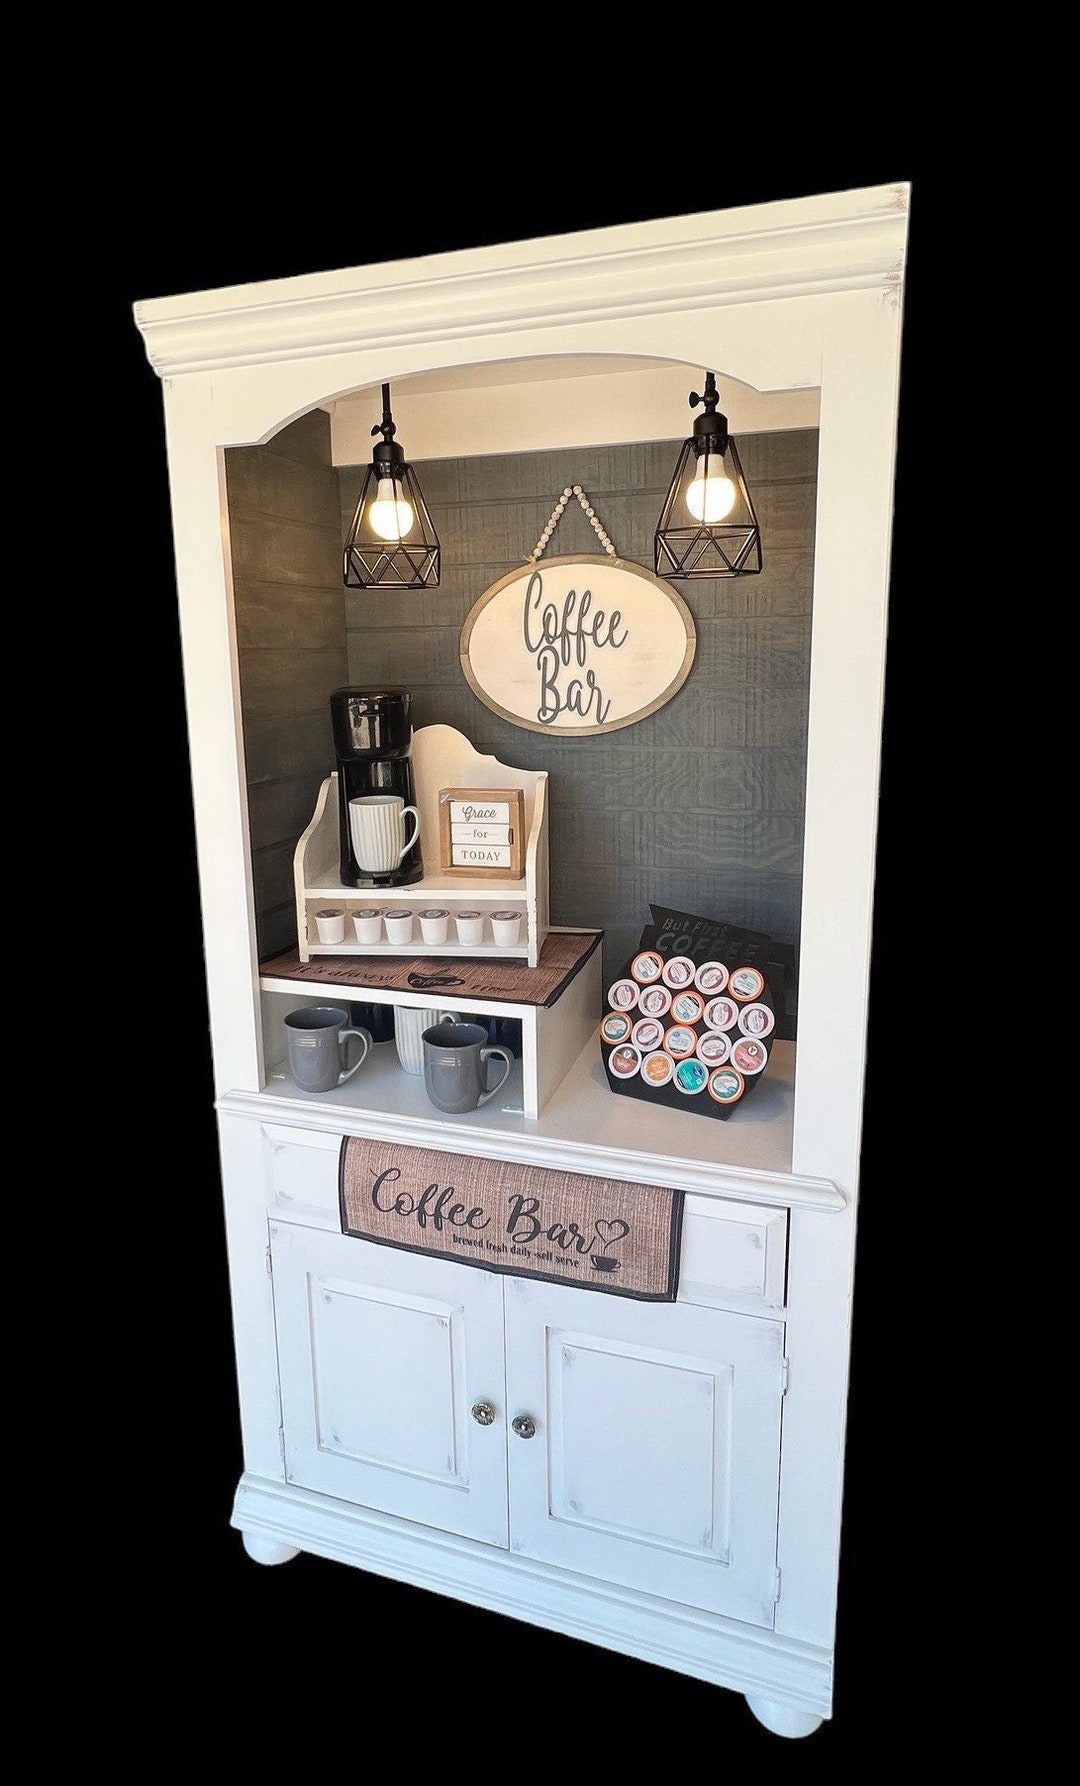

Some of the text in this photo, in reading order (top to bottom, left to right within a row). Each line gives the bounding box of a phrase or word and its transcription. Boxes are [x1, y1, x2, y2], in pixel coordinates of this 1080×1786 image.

[524, 571, 629, 667] Coffee
[537, 645, 611, 724] Bar
[461, 805, 497, 822] Grace
[472, 828, 488, 839] for
[461, 850, 501, 861] TODAY
[661, 917, 690, 932] But
[655, 932, 761, 963] COFFEE
[370, 1167, 595, 1254] Coffee Bar
[452, 1234, 484, 1248] brewed
[486, 1240, 508, 1253] fresh
[510, 1244, 531, 1258] daily
[555, 1254, 579, 1267] serve
